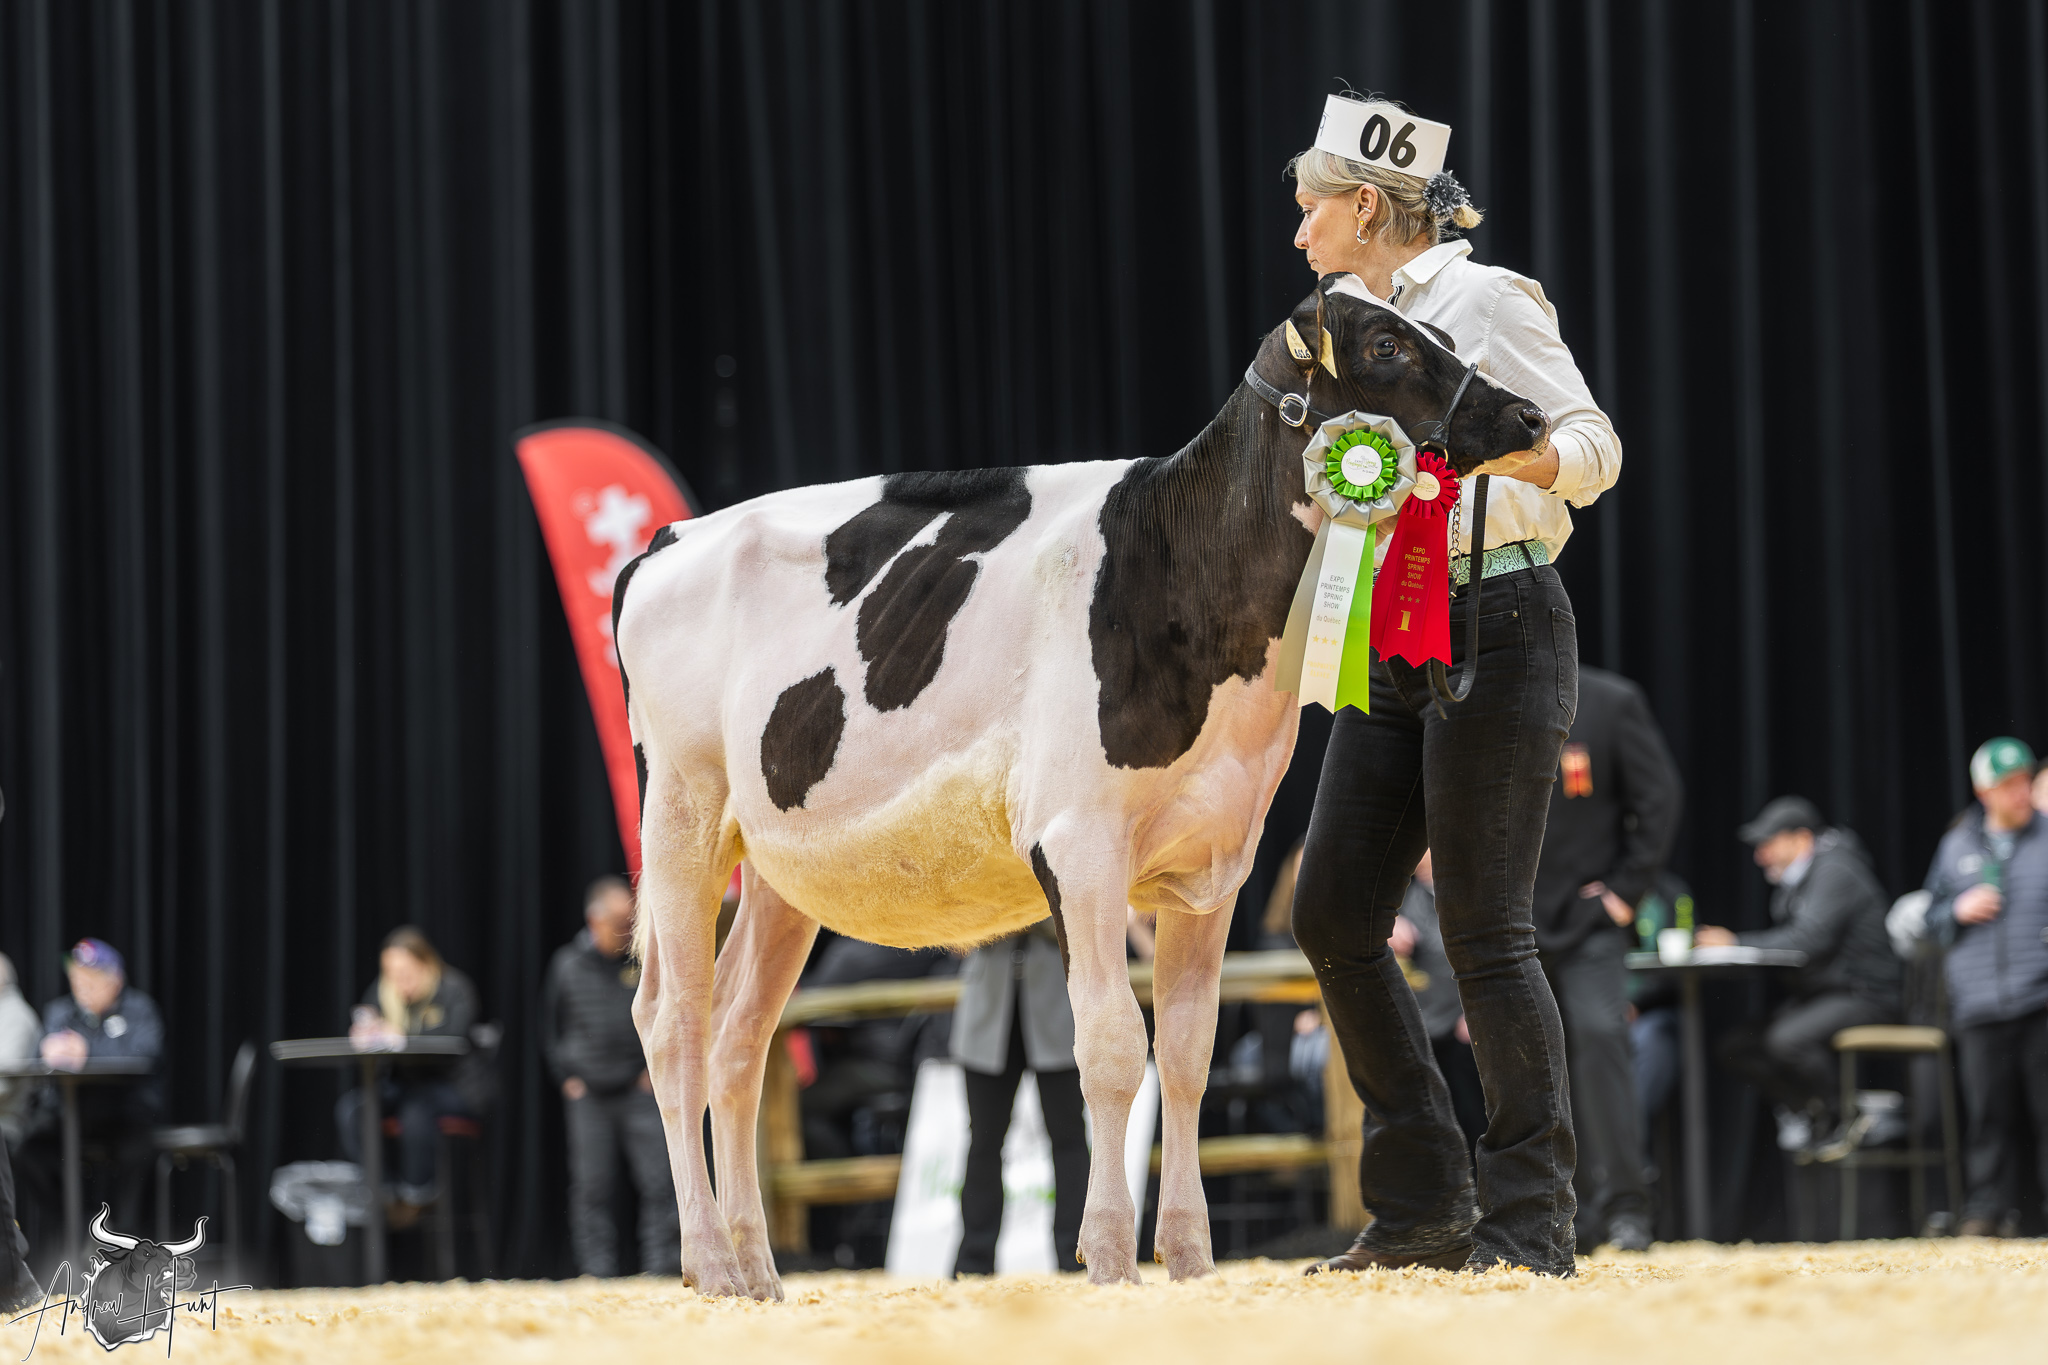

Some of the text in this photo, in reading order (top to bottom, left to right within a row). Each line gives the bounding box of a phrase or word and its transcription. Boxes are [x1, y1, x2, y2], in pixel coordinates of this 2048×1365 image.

[1360, 113, 1417, 168] 06
[1413, 546, 1425, 554] EXPO
[1405, 554, 1430, 564] PRINTEMPS
[1407, 563, 1424, 572] SPRING
[1330, 575, 1344, 583] EXPO
[1320, 583, 1350, 593] PRINTEMPS
[1323, 592, 1343, 601] SPRING
[1397, 609, 1411, 632] 1
